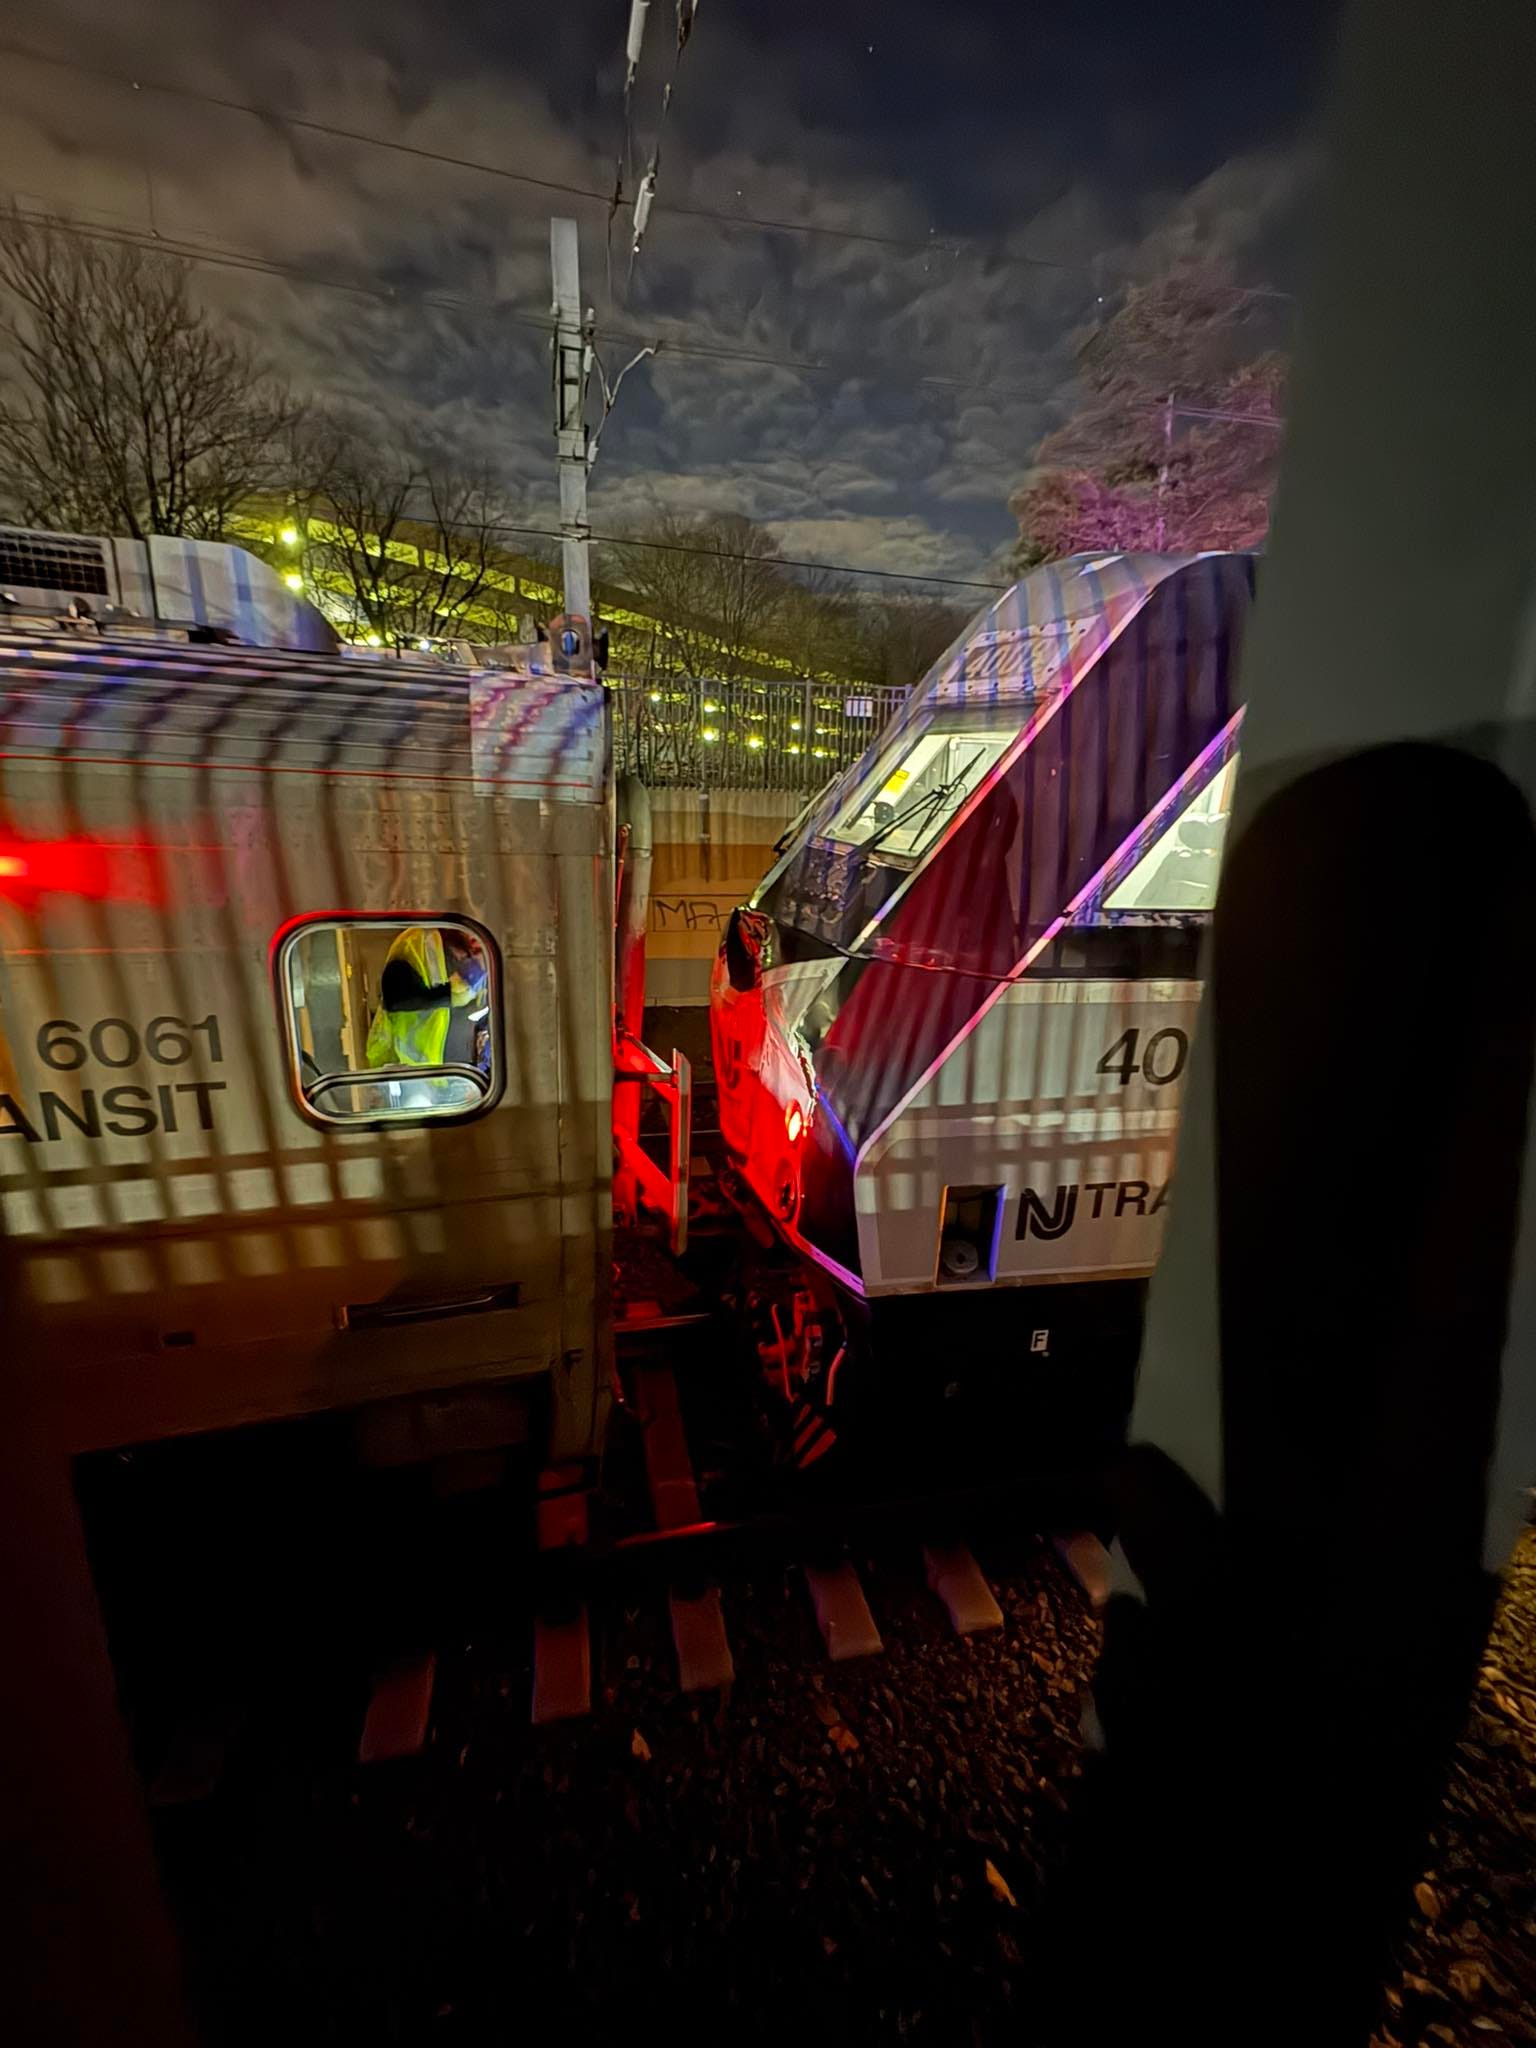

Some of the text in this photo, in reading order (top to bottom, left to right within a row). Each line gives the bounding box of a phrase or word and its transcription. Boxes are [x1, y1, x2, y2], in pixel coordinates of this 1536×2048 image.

[37, 1014, 224, 1071] 6061
[1096, 1027, 1189, 1086] 40
[0, 1081, 226, 1142] ANSIT
[1033, 1332, 1047, 1349] F
